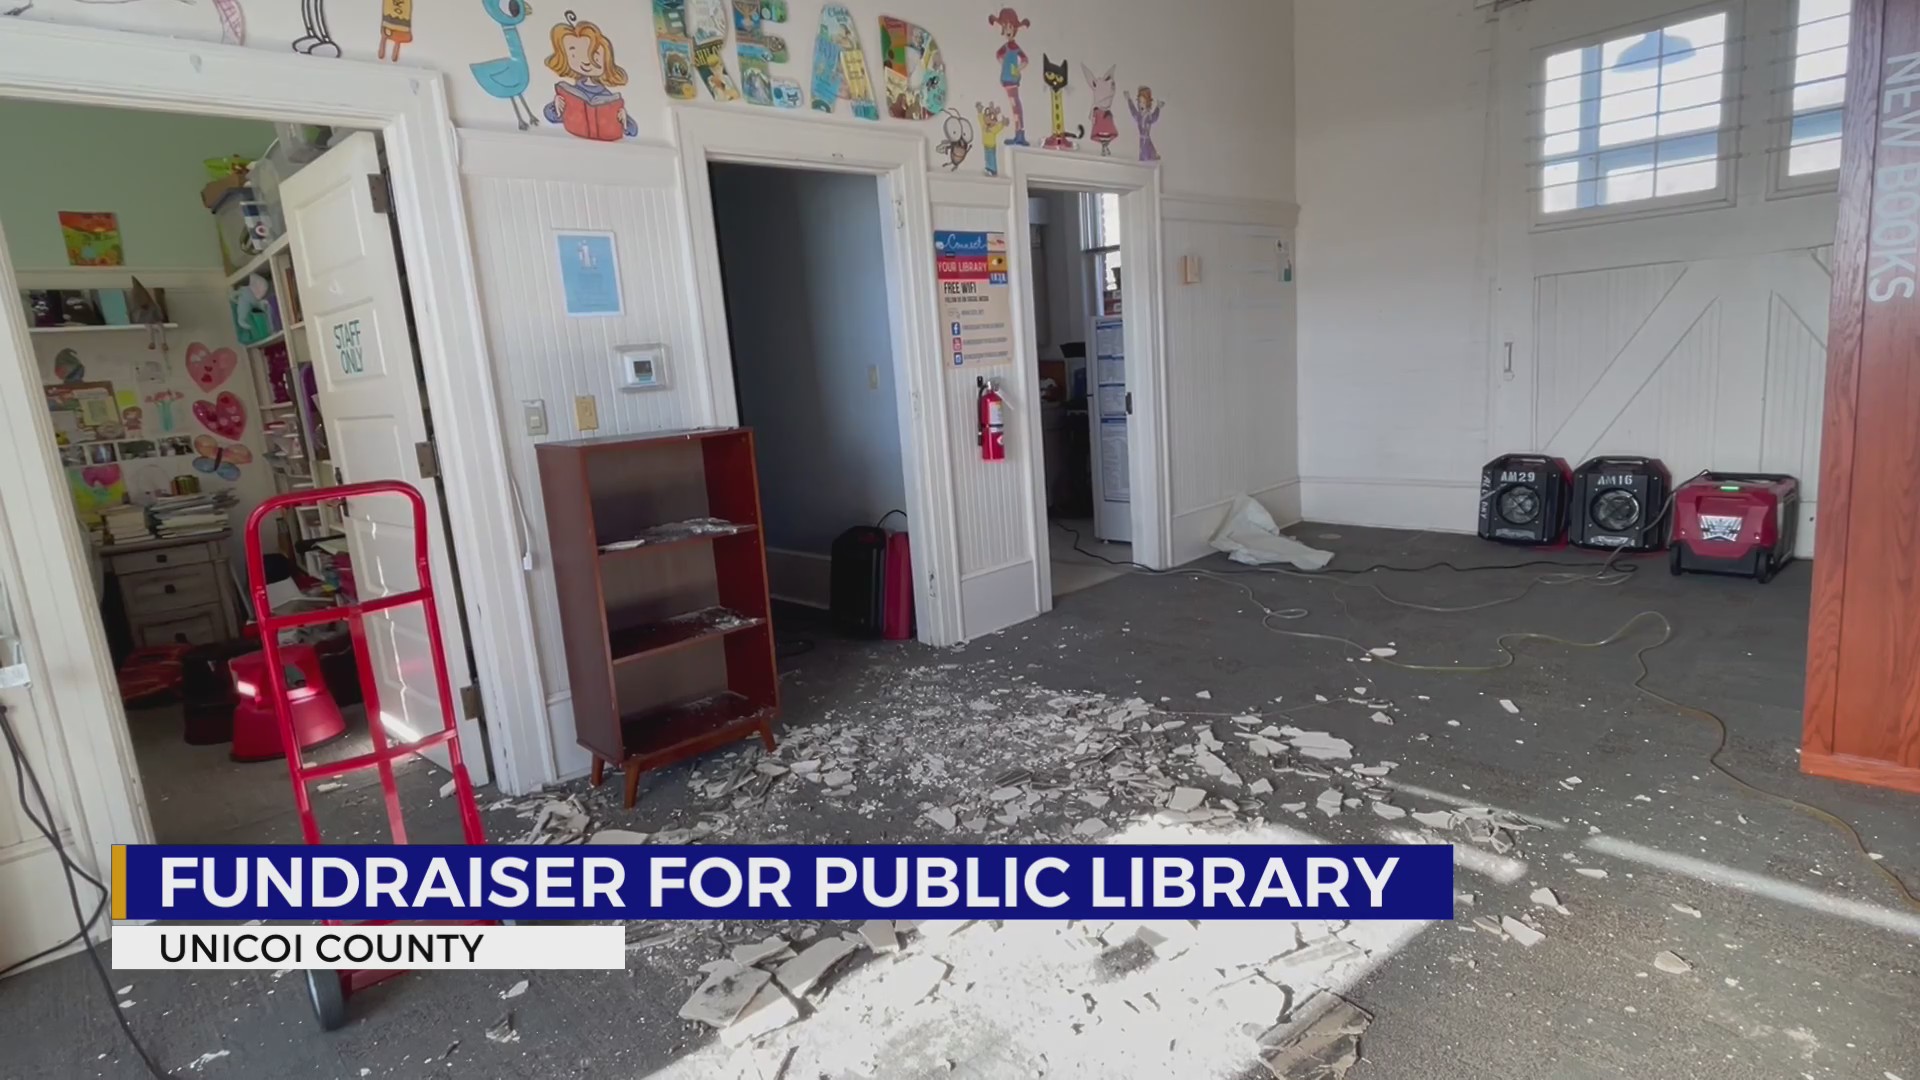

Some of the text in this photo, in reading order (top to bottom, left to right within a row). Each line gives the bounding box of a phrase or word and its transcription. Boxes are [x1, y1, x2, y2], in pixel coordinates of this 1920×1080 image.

[651, 0, 947, 121] READ
[1868, 52, 1920, 302] NEW BOOKS
[938, 262, 987, 273] YOUR LIBRARY
[944, 282, 960, 294] FREE
[333, 319, 361, 350] STAFF
[341, 346, 363, 374] ONLY
[1500, 471, 1536, 483] AM29
[1597, 474, 1633, 485] AM16
